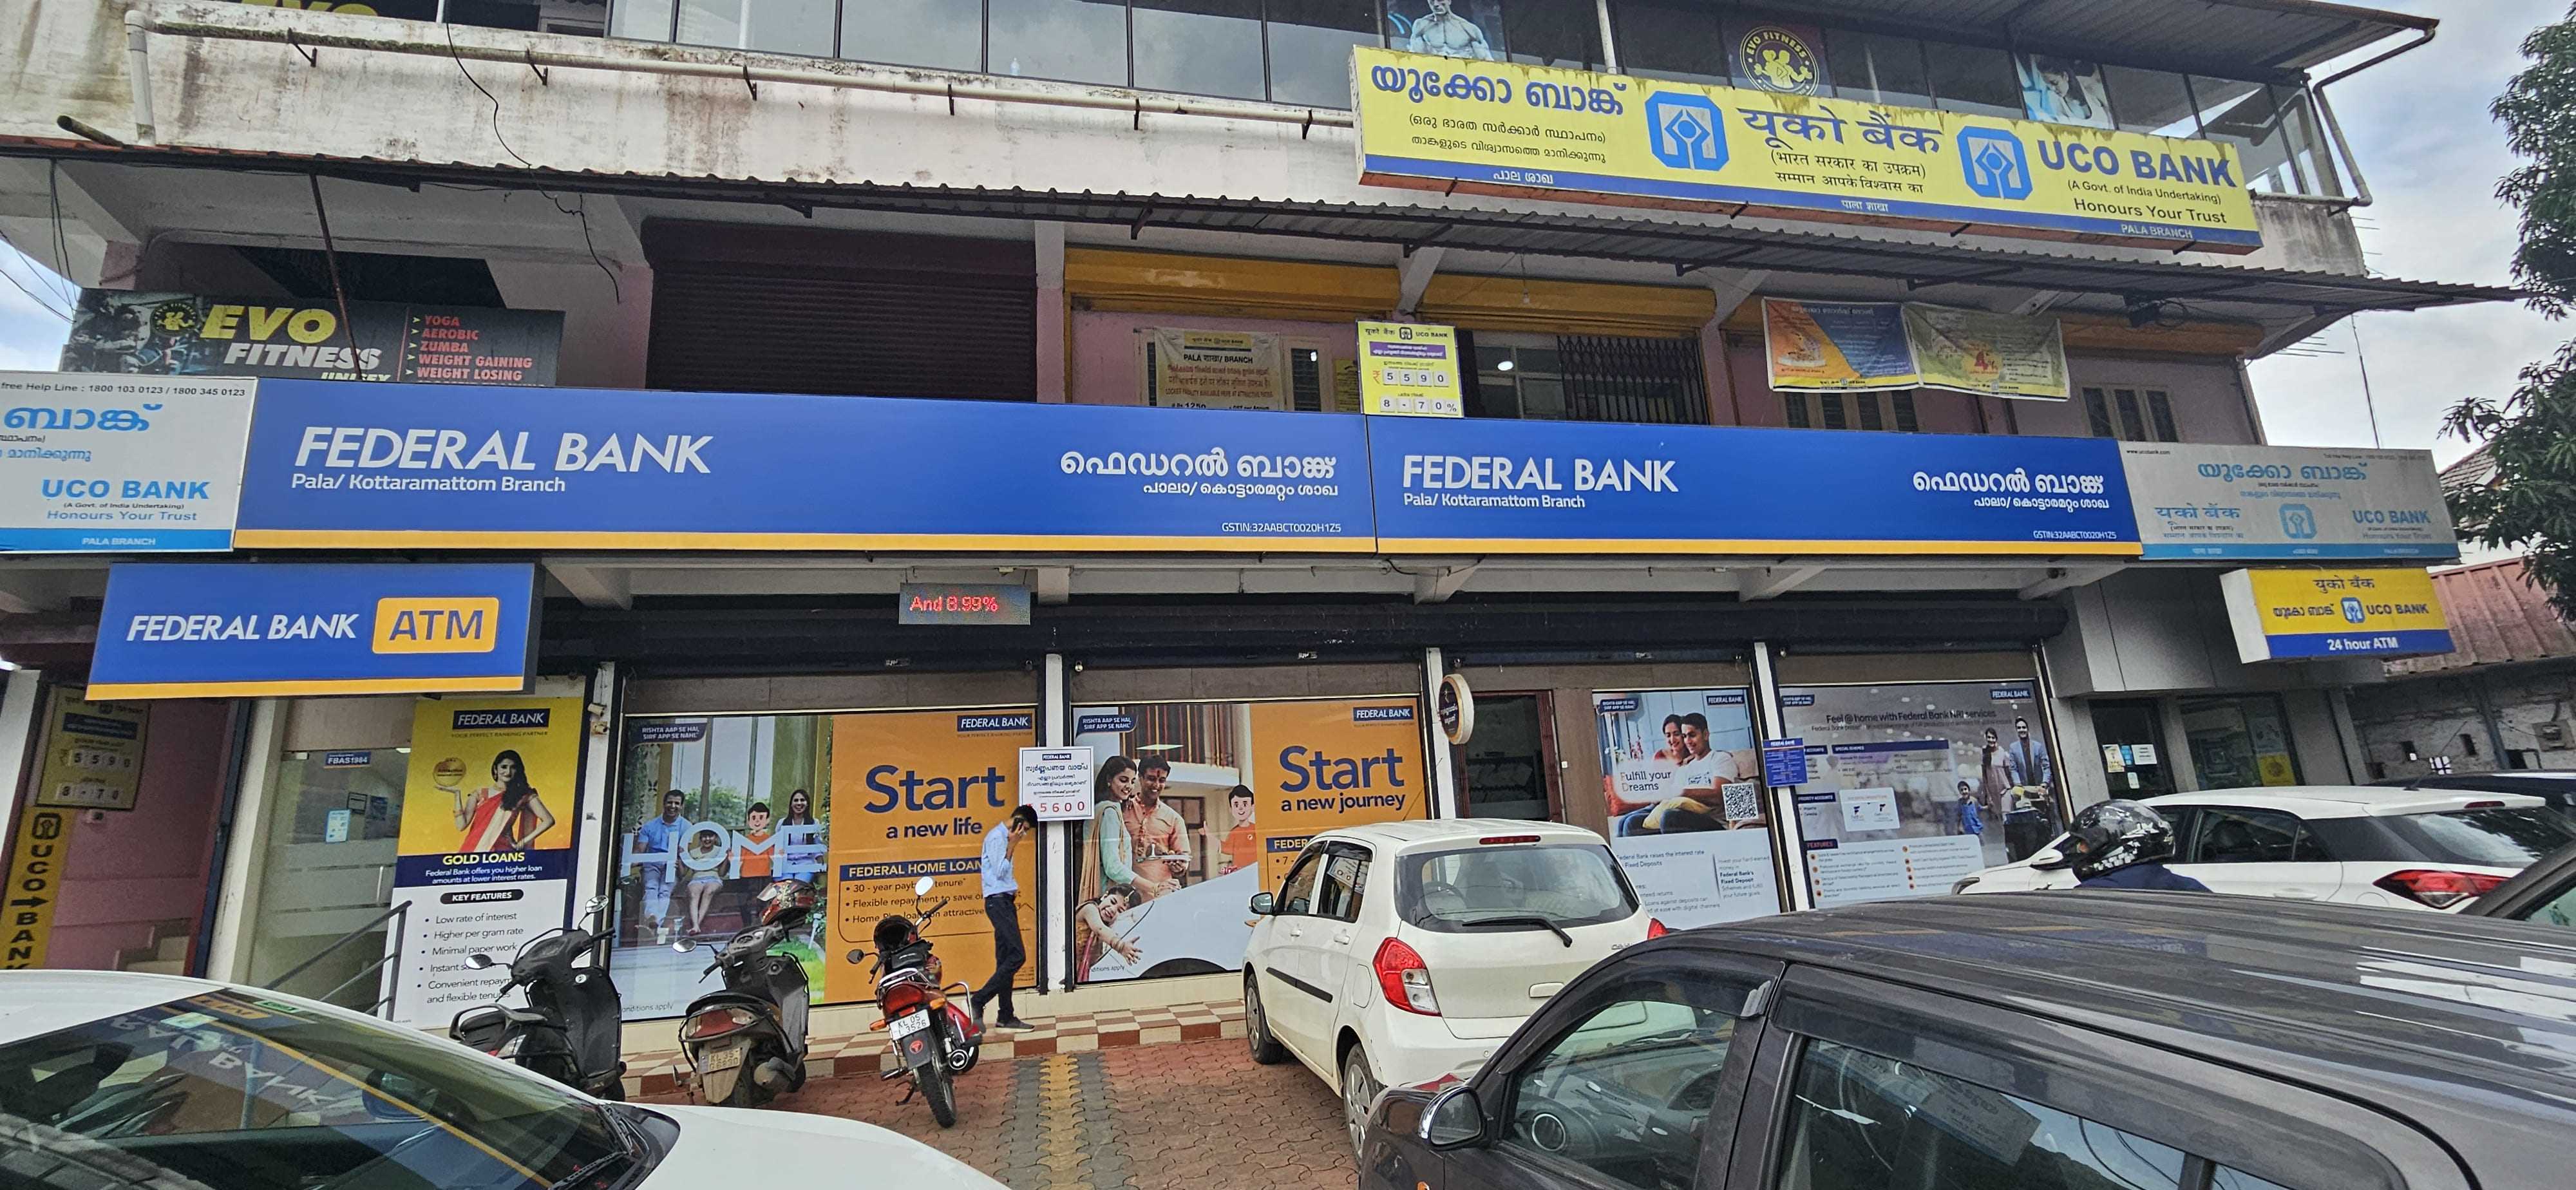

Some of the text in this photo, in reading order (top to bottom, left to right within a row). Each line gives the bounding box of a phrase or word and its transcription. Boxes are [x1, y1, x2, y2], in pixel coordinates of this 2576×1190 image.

[1371, 65, 1627, 115] യൂക്കോ ബാങ്ക്
[1409, 113, 1437, 129] (ഒരു
[1443, 118, 1477, 131] ഭാരത
[1736, 105, 1943, 154] यूको बैंक
[1770, 149, 1810, 166] (भारत
[1814, 155, 1855, 170] सरकार
[1861, 159, 1878, 173] का
[2037, 139, 2237, 188] UCO BANK
[1493, 170, 1553, 184] പാല ശാഖ
[1775, 171, 1815, 184] सम्मान
[2067, 179, 2222, 205] (A Govt. of India Undertaking)
[2073, 197, 2227, 224] Honours Your Trust
[2121, 224, 2193, 239] PALA BRANCH
[200, 304, 336, 344] EVO
[424, 315, 461, 326] YOGA
[422, 329, 480, 341] AEROBIC
[420, 341, 469, 353] ZUMBA
[224, 342, 383, 370] FITNESS
[418, 354, 533, 368] WEIGHT GAINING
[1184, 354, 1253, 364] PALA BRANCH
[417, 367, 522, 381] WEIGHT LOSING
[26, 383, 51, 392] Help
[55, 383, 78, 392] Line
[118, 385, 135, 393] 103
[4, 403, 163, 431] ബാങ്ക്
[294, 426, 714, 473] FEDERAL BANK
[1060, 446, 1337, 479] ഫെഡറൽ ബാങ്ക്
[1403, 455, 1680, 492] FEDERAL BANK
[291, 473, 565, 493] Pala/ Kottaramattom Branch
[1913, 468, 2104, 495] ഫെഡറൽ ബാങ്ക്
[41, 479, 211, 500] UCO BANK
[1298, 484, 1338, 496] ശാഖ
[1403, 493, 1586, 508] Pala/ Kottaramattom Branch
[47, 511, 197, 521] Honours Your Trust
[2352, 510, 2431, 524] UCO BANK
[1222, 522, 1341, 533] GSTIN:32AABCT0020H1Z5
[909, 595, 943, 612] And
[2365, 603, 2429, 615] UCO BANK
[127, 609, 484, 641] FEDERAL BANK ATM
[2327, 637, 2398, 651] 24 hour ATM
[458, 712, 545, 726] FEDERAL BANK
[1356, 708, 1411, 719] FEDERAL BANK
[1826, 710, 1964, 724] Feel home with Federal Bank NRI
[961, 716, 1028, 728] FEDERAL BANK
[1279, 746, 1405, 793] Start
[1620, 771, 1671, 782] Fulfill your
[864, 764, 1005, 813] Start
[1622, 782, 1659, 792] Dreams
[1281, 793, 1406, 813] a new journey
[886, 817, 983, 839] a new life
[620, 820, 828, 883] HOME
[442, 853, 526, 865] GOLD LOANS
[23, 844, 54, 892] UCO
[426, 869, 451, 877] Federal
[505, 866, 526, 874] higher
[849, 862, 946, 878] FEDERAL HOME
[873, 883, 893, 892] year
[471, 892, 512, 901] FEATURES
[853, 898, 888, 908] Flexible
[435, 912, 517, 924] Low rate of interest
[853, 908, 985, 924] Home attractive
[434, 930, 463, 941] Higher
[464, 930, 480, 940] per
[482, 929, 504, 939] gram
[432, 943, 517, 956] Minimal paper work
[430, 963, 459, 972] Instant
[428, 979, 478, 990] Convenient
[426, 992, 477, 1004] and flexible
[655, 1003, 674, 1012] apply
